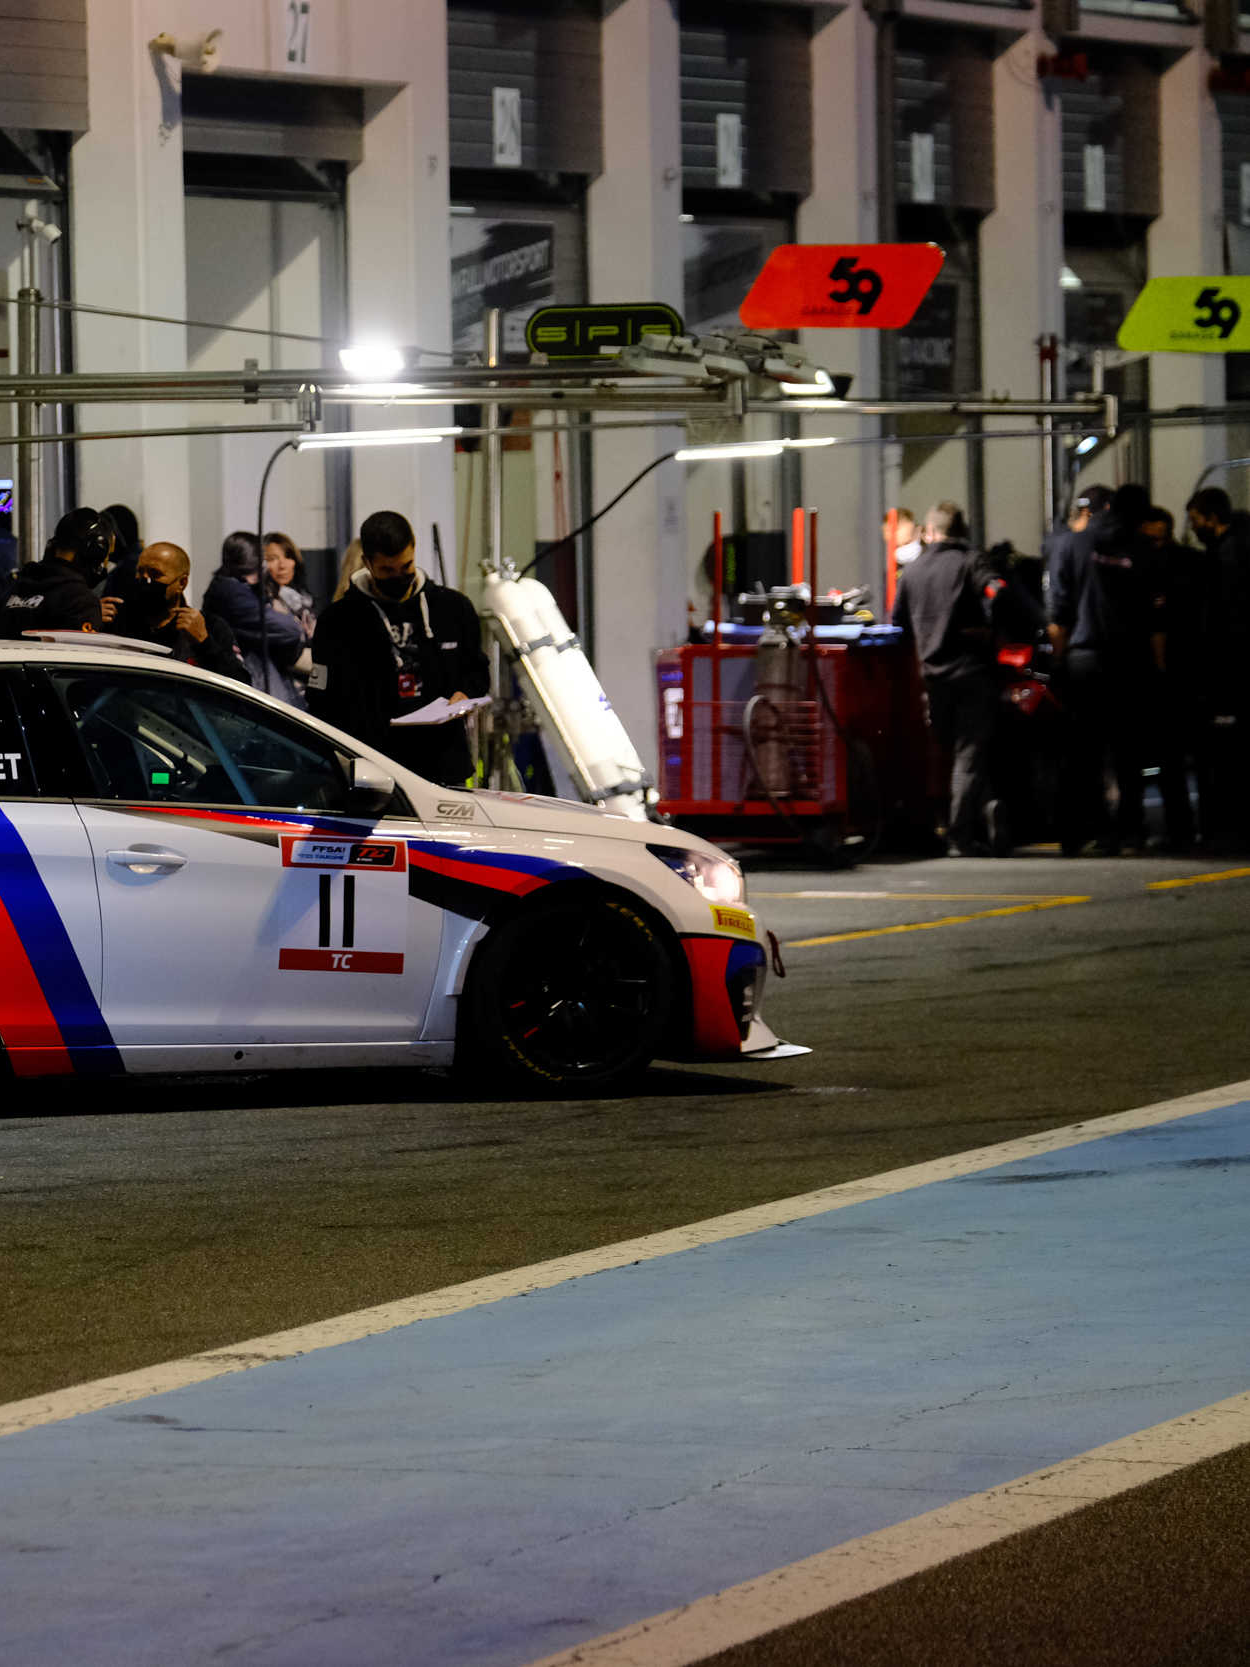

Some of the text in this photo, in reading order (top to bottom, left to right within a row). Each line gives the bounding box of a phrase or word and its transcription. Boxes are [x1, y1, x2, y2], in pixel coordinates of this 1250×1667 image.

[828, 257, 883, 315] 59
[1194, 286, 1241, 339] 59
[331, 953, 353, 969] TC
